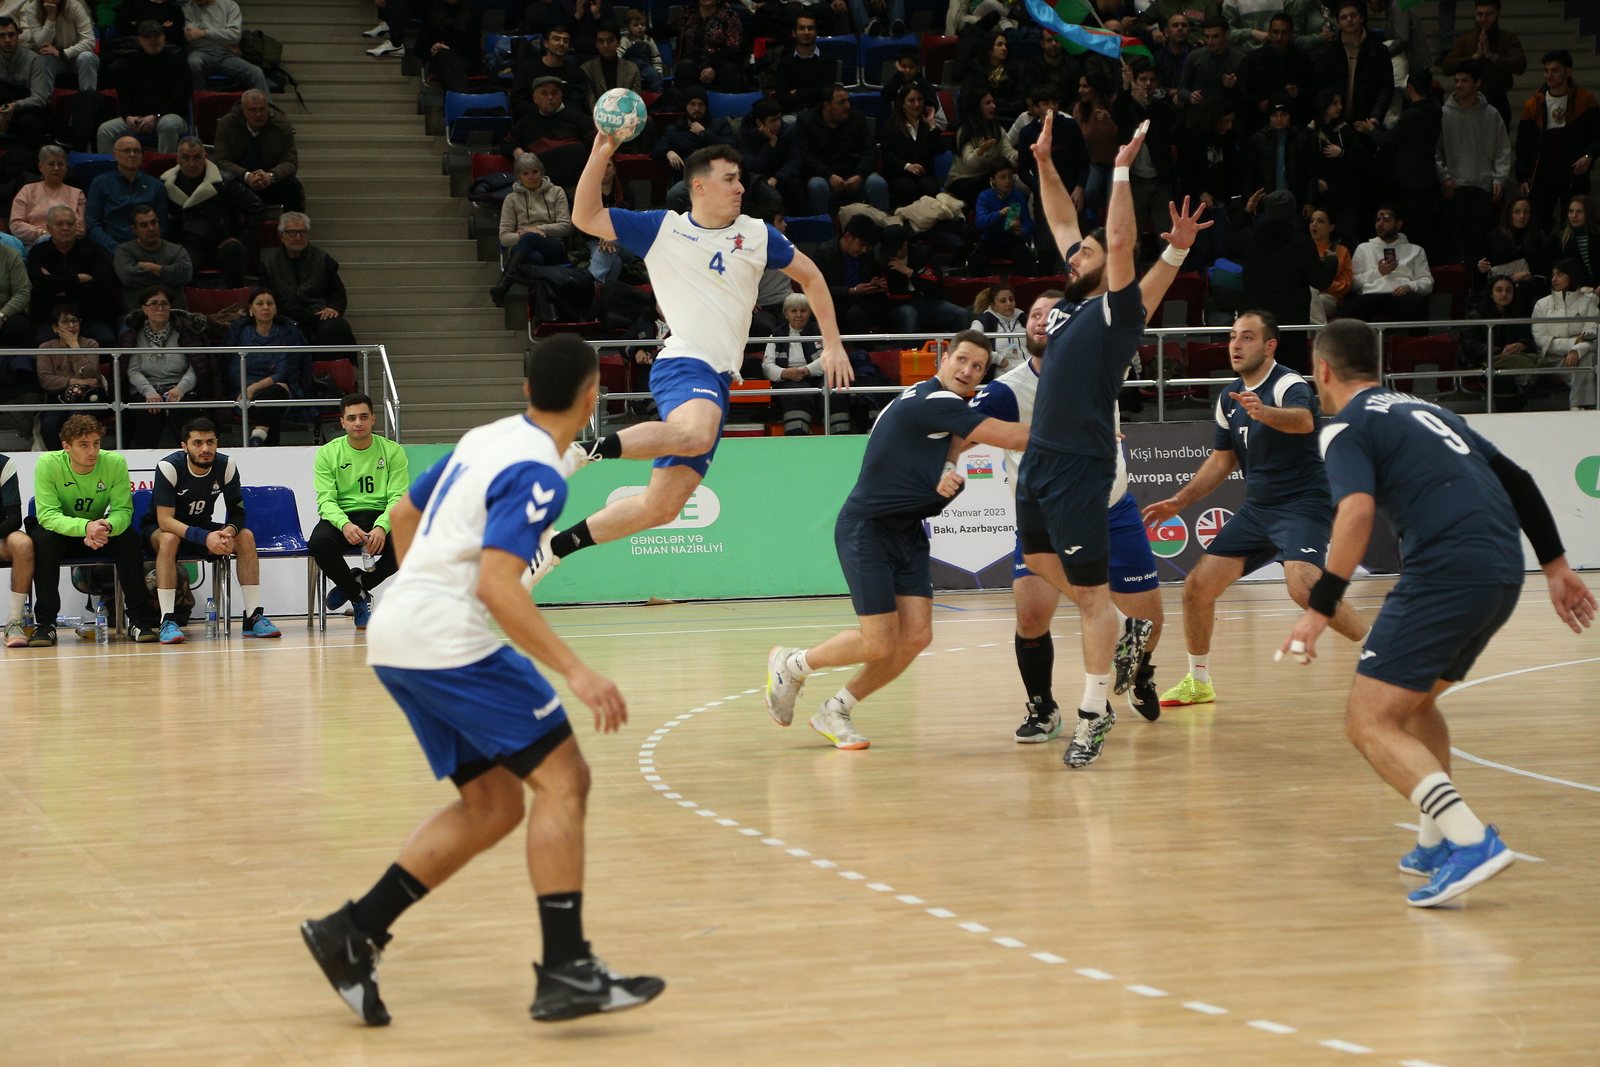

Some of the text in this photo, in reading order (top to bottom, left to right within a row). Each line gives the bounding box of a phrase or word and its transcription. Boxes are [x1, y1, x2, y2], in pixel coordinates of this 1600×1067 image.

[709, 251, 726, 276] 4
[1045, 308, 1072, 335] 97
[1239, 426, 1249, 449] 7
[1411, 409, 1471, 455] 9
[1130, 446, 1213, 462] Kişi həndbolc
[357, 475, 374, 493] 16
[1127, 473, 1173, 484] Avropa
[74, 498, 94, 512] 87
[188, 500, 205, 515] 19
[951, 509, 982, 517] Yanvar
[984, 508, 1006, 517] 2023
[959, 524, 1015, 534] Azərbaycan
[630, 534, 704, 545] GƏNCLƏR VƏ
[631, 542, 723, 555] İDMAN NAZİRLİYİ
